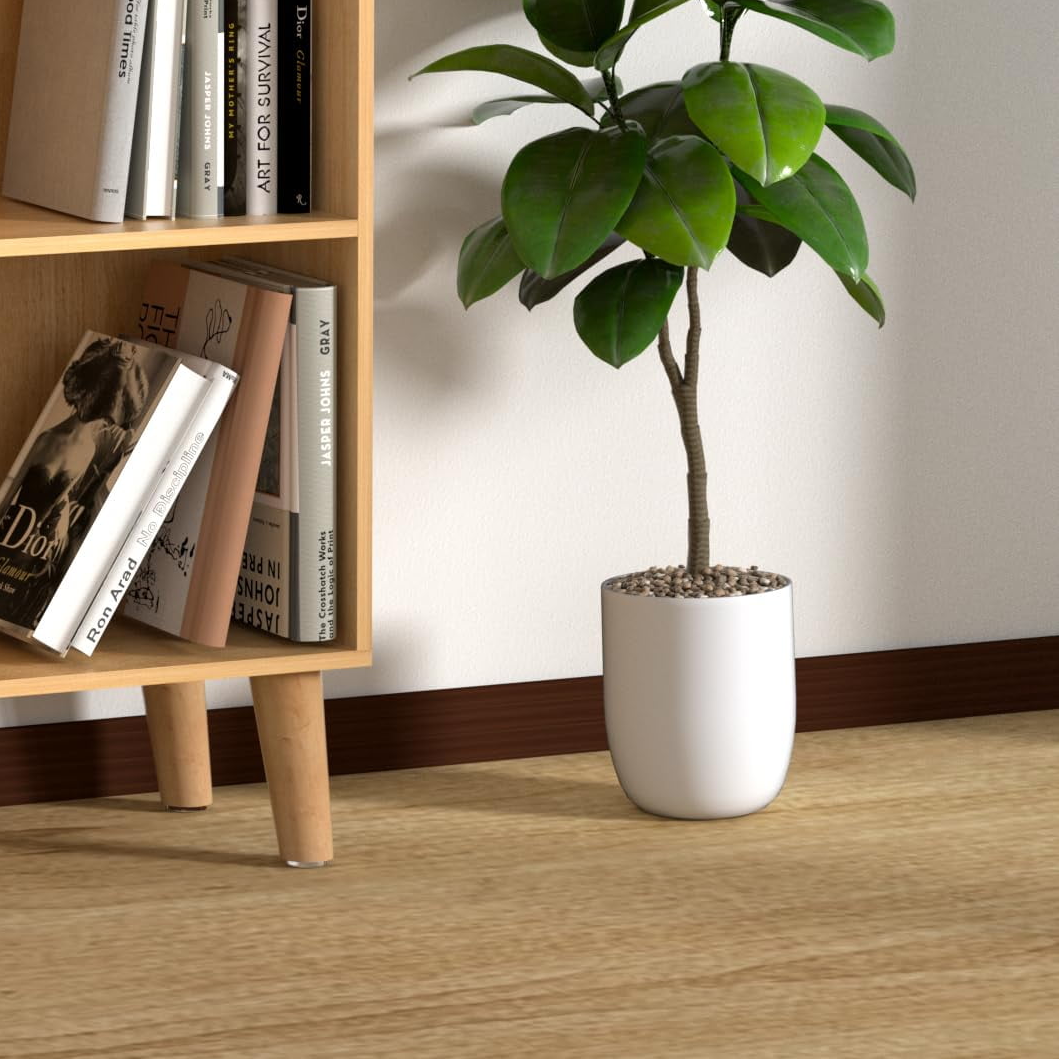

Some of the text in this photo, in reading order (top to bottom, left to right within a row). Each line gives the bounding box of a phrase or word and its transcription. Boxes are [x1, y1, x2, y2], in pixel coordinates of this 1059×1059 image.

[296, 5, 308, 39] Dior
[118, 32, 132, 78] Times
[258, 23, 271, 193] ART FOR SURVIVAL
[229, 124, 234, 139] MY
[320, 319, 332, 466] JASPER JOHNS GRAY
[86, 431, 205, 643] Ron Arad No Discipline
[237, 576, 280, 607] JOHNS
[268, 559, 280, 580] IN
[318, 531, 326, 641] The Crosshatch Works
